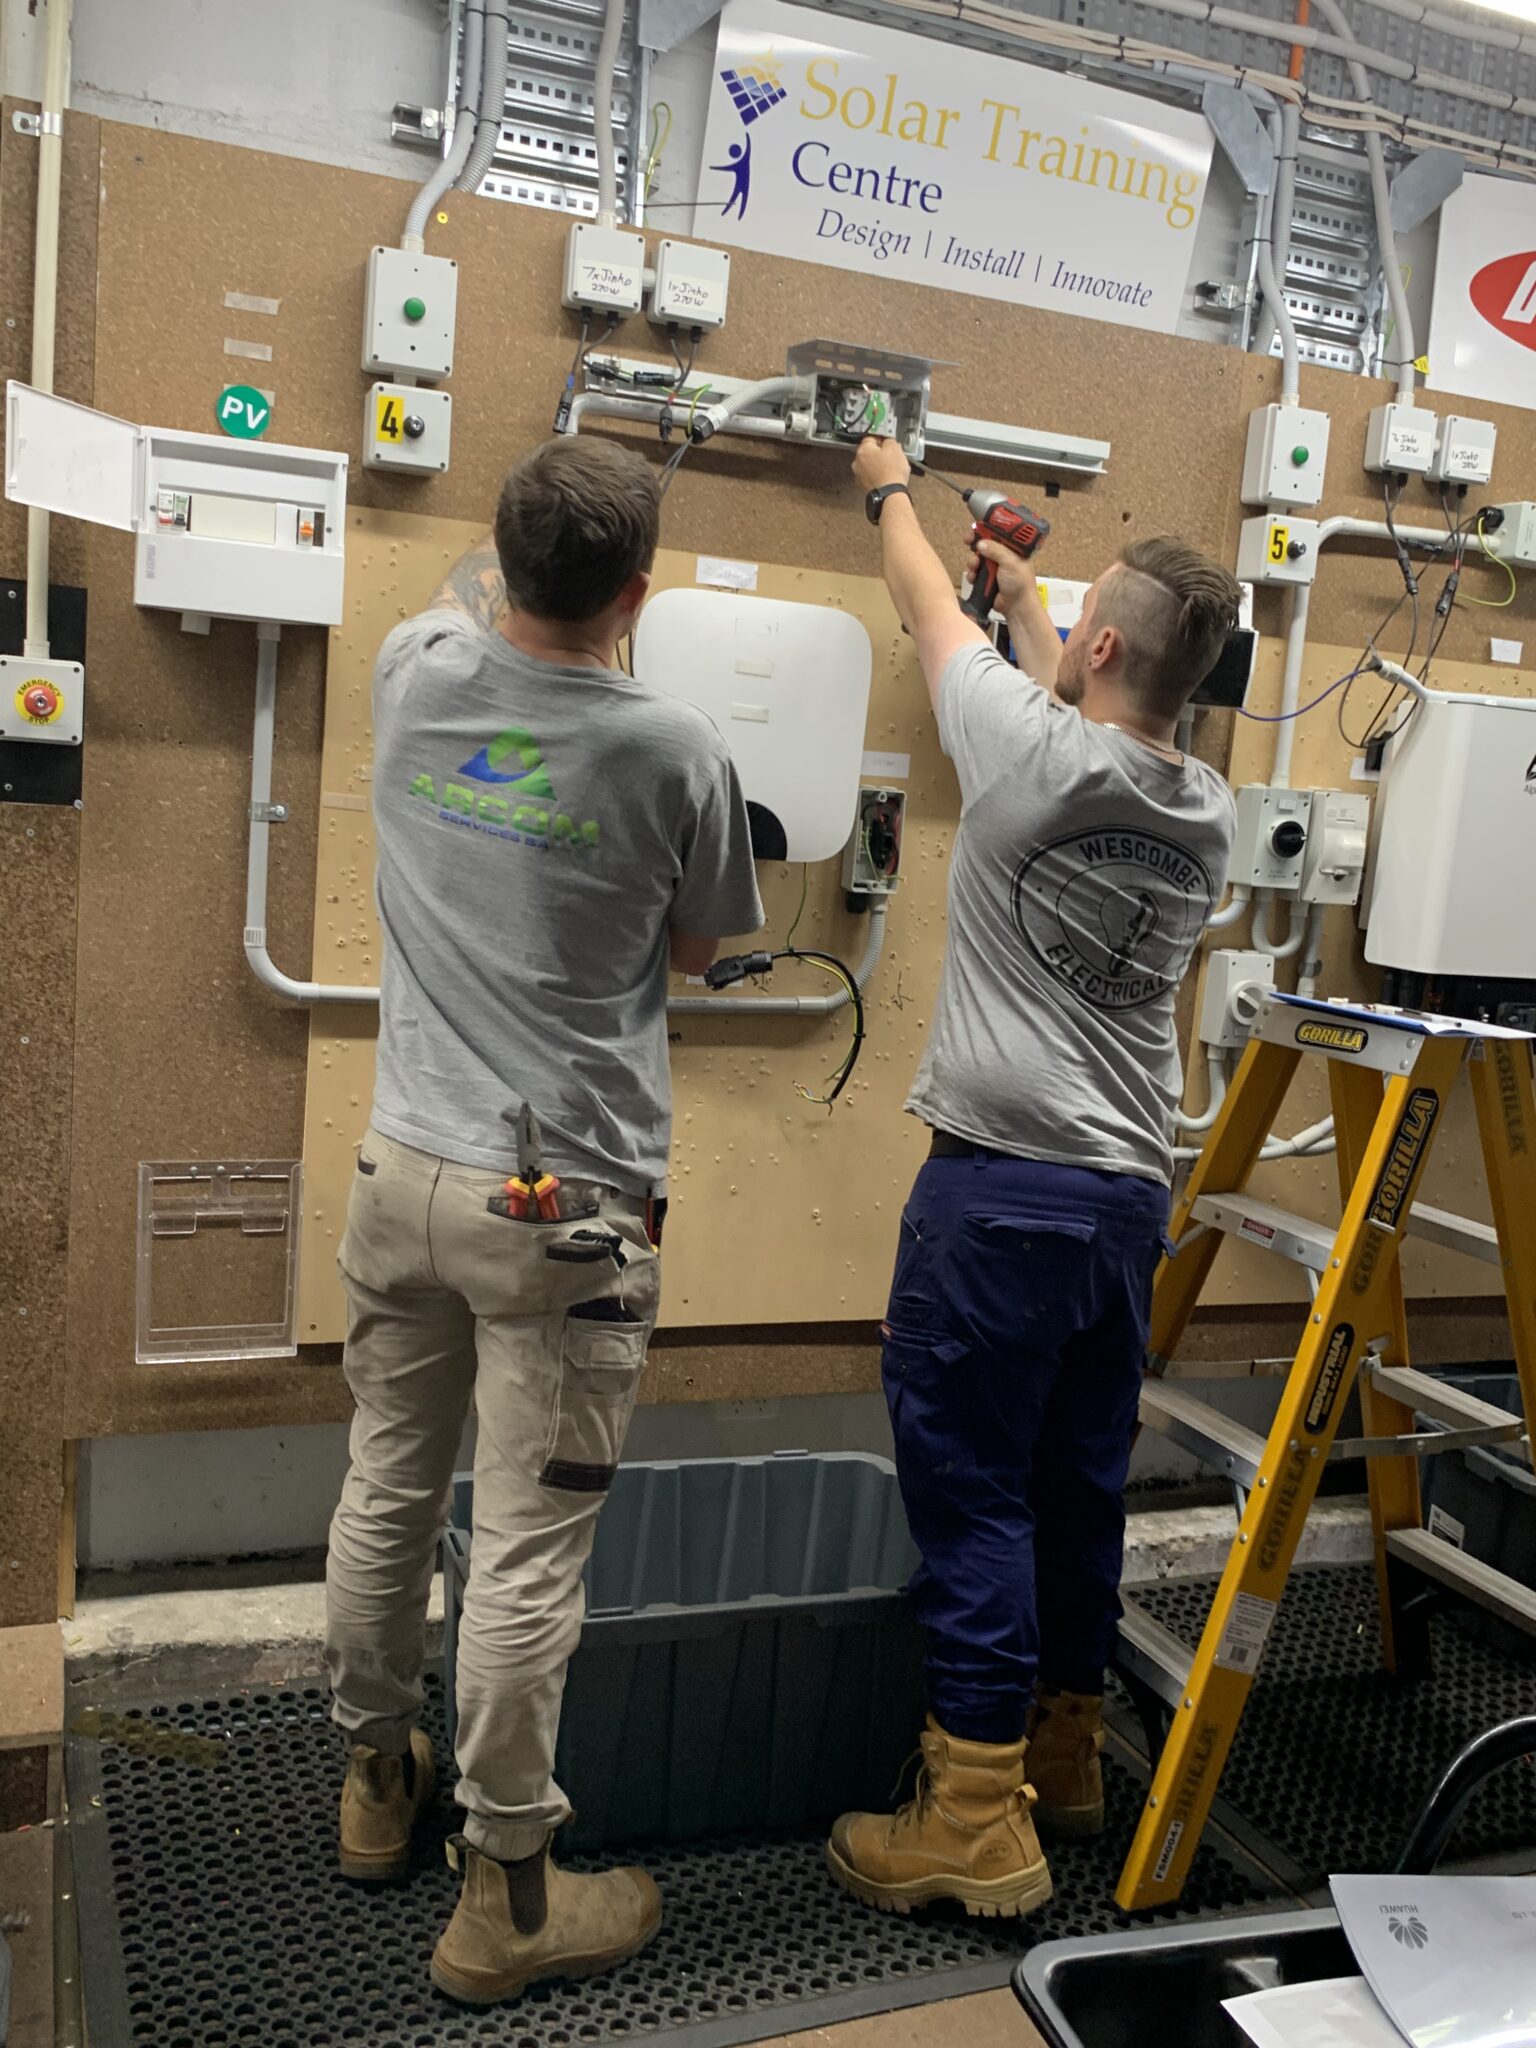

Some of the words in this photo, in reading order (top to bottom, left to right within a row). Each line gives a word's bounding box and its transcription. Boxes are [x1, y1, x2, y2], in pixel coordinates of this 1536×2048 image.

[800, 57, 960, 150] Solar
[981, 98, 1201, 230] Training
[792, 140, 943, 213] Centre
[817, 208, 910, 260] Design
[943, 236, 1025, 280] Install
[1050, 261, 1153, 308] Innovate
[222, 396, 267, 430] PV
[380, 401, 399, 439] 4
[1271, 529, 1285, 560] 5
[17, 679, 62, 697] EMERGENCY
[1079, 836, 1201, 894] WESCOMBE
[1298, 1024, 1364, 1052] GORILLA
[1369, 1094, 1438, 1229] GORILLA
[1307, 1331, 1346, 1426] INDUSTRIAL
[1379, 1904, 1420, 1914] HUAWEI
